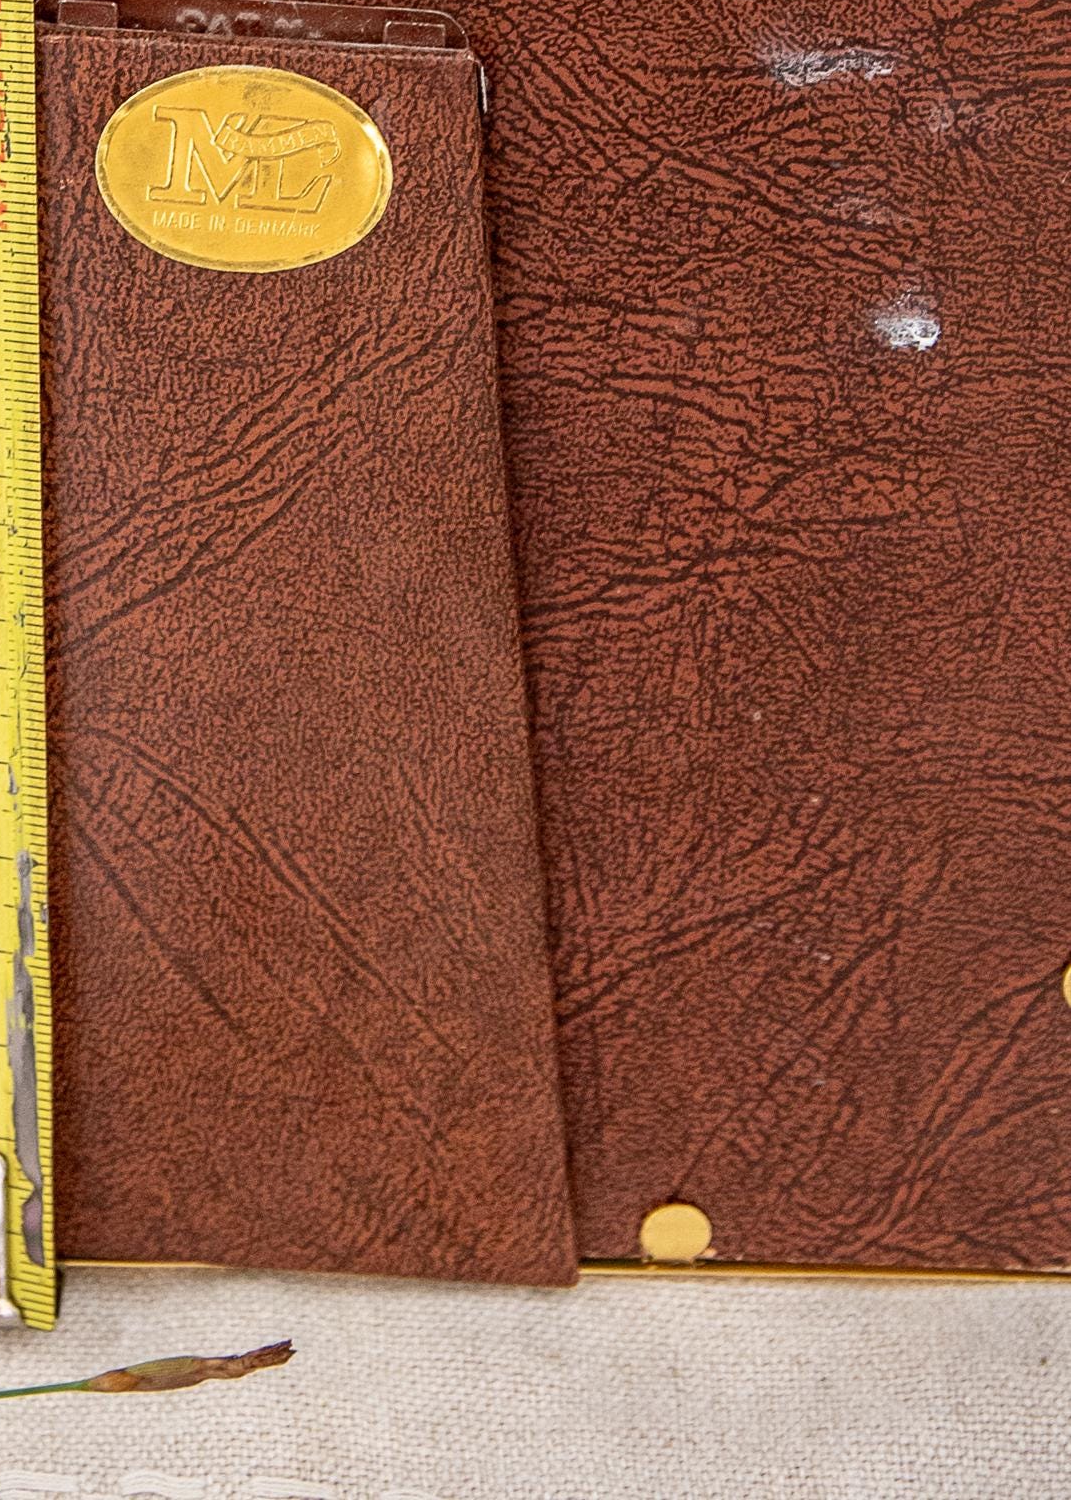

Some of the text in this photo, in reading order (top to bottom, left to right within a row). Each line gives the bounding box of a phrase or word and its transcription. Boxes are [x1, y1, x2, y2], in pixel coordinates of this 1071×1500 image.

[152, 211, 321, 238] MADE IN DENMARK
